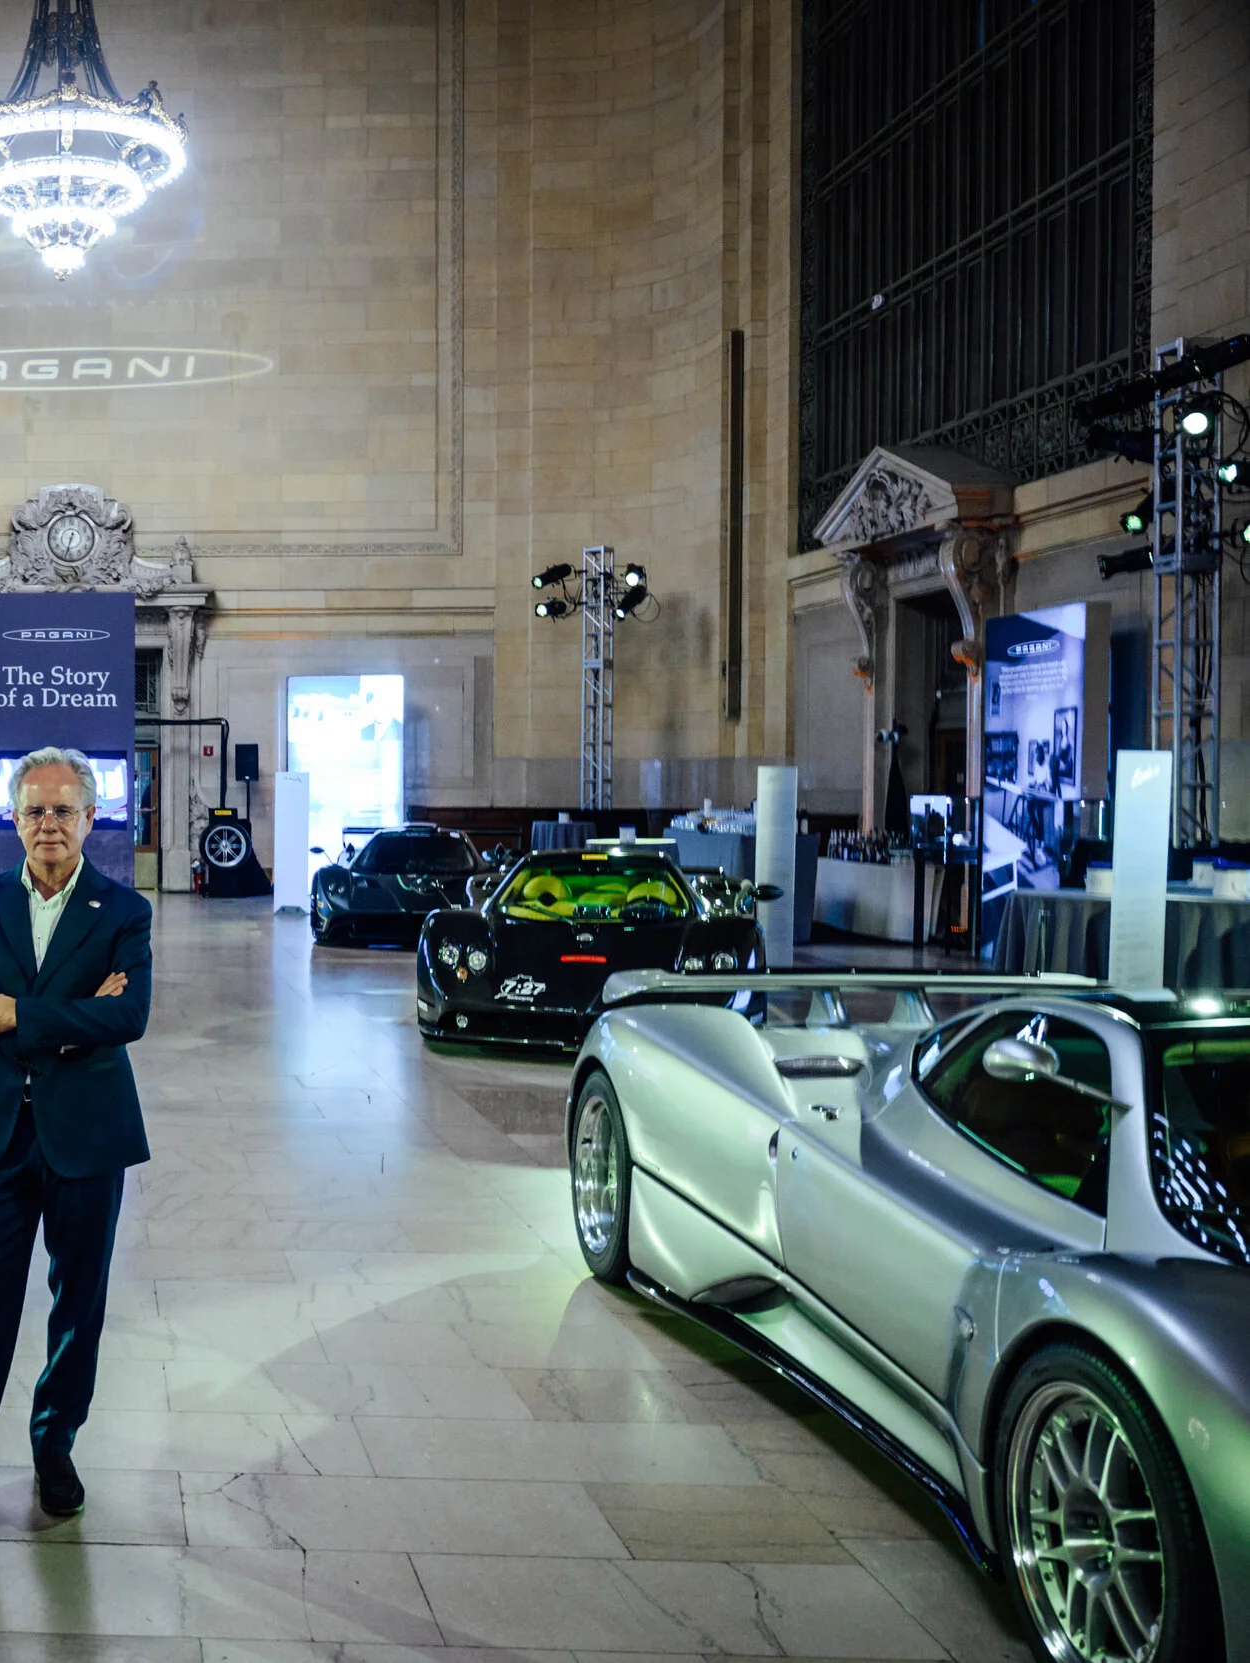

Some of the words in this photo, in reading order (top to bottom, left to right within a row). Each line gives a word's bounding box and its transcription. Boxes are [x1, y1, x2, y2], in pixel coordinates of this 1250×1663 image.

[20, 631, 94, 639] PAGANI
[1015, 641, 1052, 655] PAGANI
[2, 665, 44, 685] The
[50, 665, 110, 692] Story
[22, 693, 36, 708] a
[41, 687, 118, 708] Dream
[504, 980, 546, 996] 7:27
